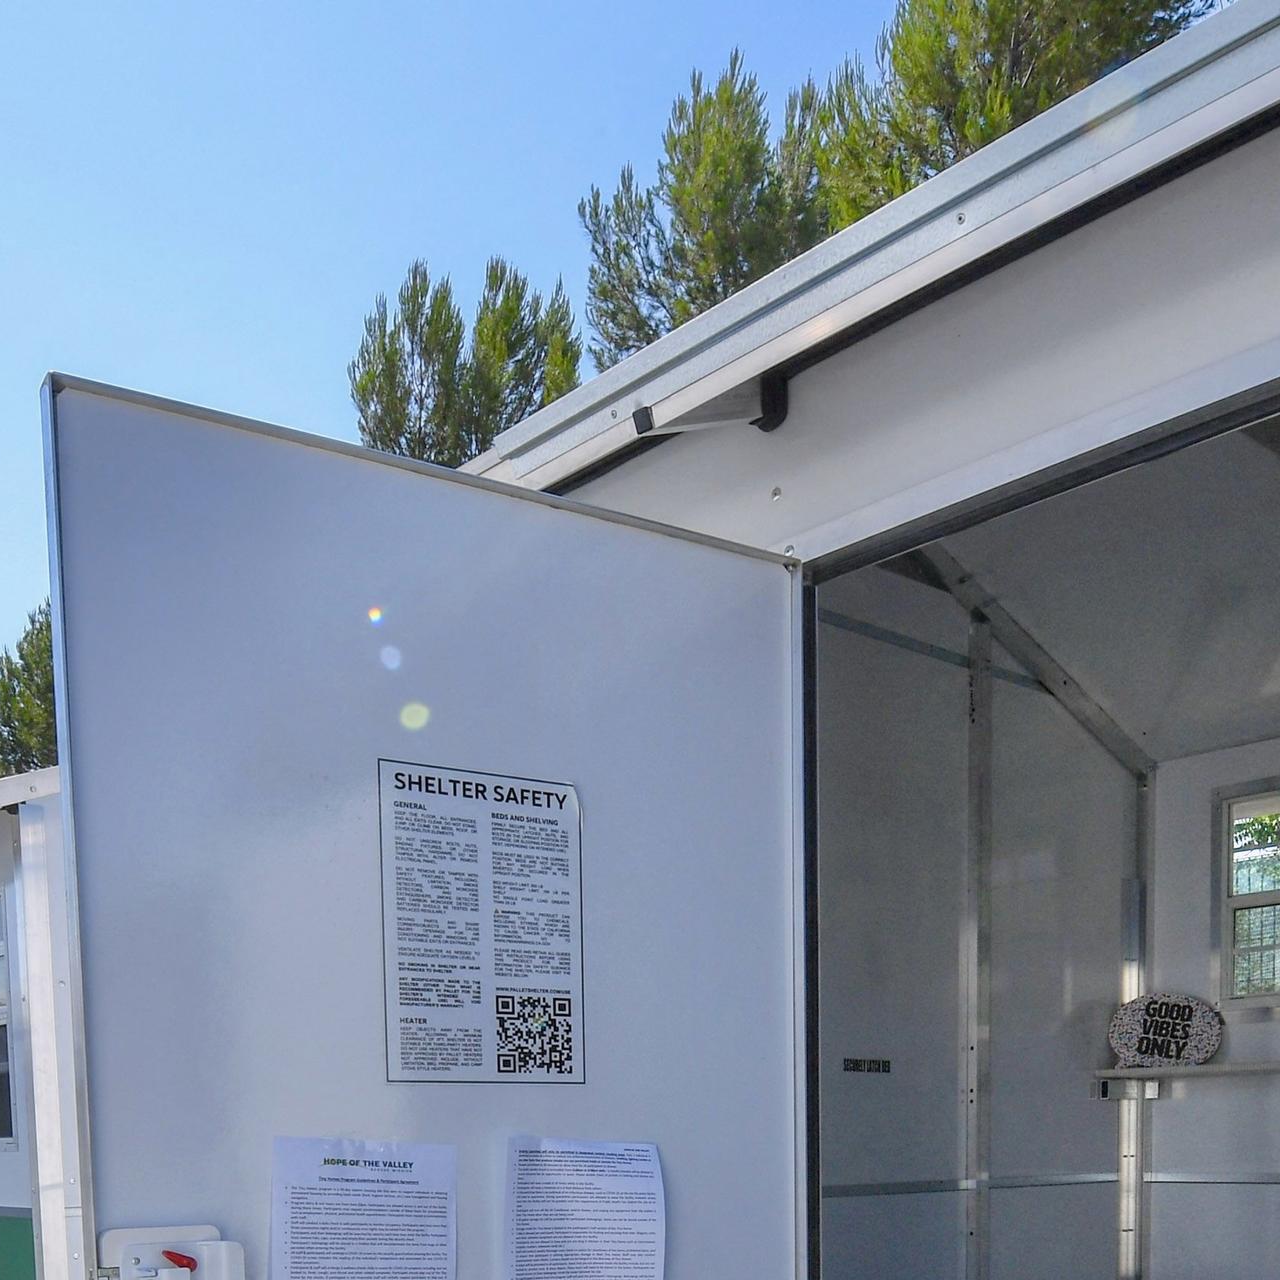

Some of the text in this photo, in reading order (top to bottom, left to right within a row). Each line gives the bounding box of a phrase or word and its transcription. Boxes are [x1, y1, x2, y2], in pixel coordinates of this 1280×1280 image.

[394, 772, 567, 810] SHELTER SAFETY
[394, 801, 427, 811] GENERAL
[491, 812, 558, 826] BEDS AND SHELVING
[1145, 1000, 1194, 1021] GOOD
[399, 1017, 427, 1025] HEATER
[1143, 1018, 1192, 1040] VIBES
[1136, 1036, 1188, 1060] ONLY
[323, 1157, 414, 1169] HOPE OF THE VALLEY
